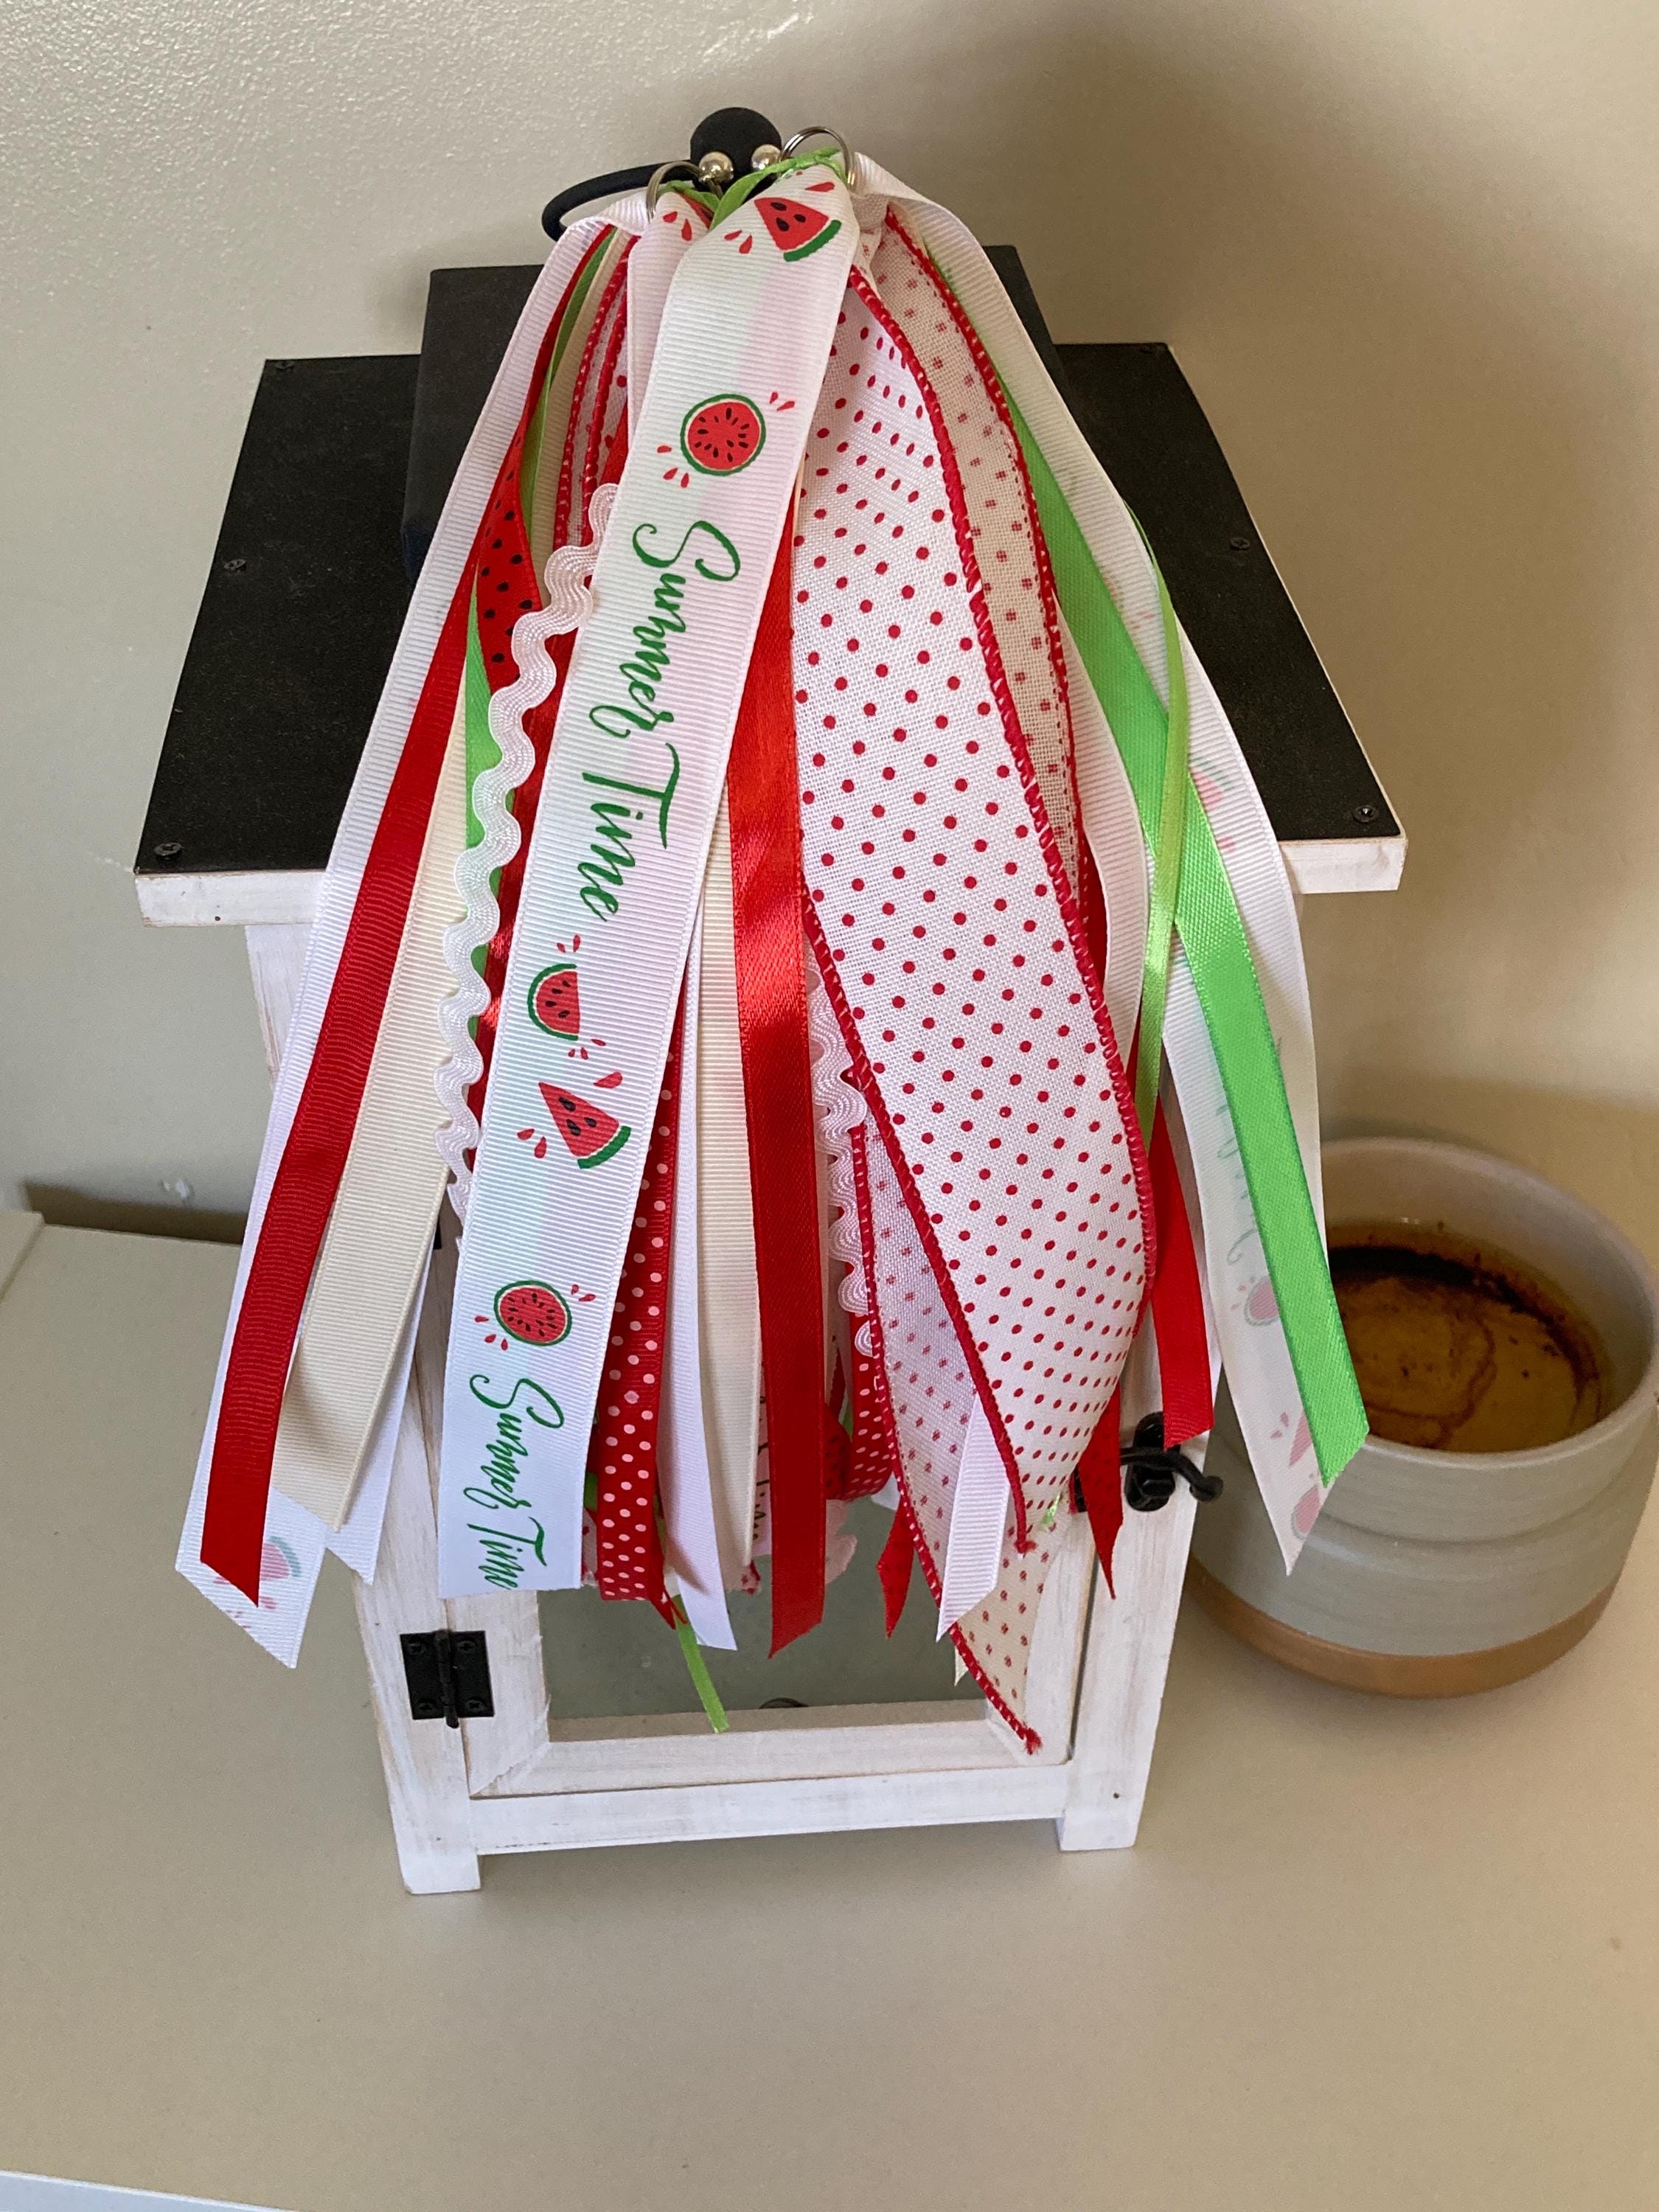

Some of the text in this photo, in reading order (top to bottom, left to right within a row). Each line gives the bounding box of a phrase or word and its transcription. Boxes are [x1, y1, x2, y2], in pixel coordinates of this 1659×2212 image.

[577, 520, 740, 922] Summer Time
[462, 1374, 565, 1509] Summer
